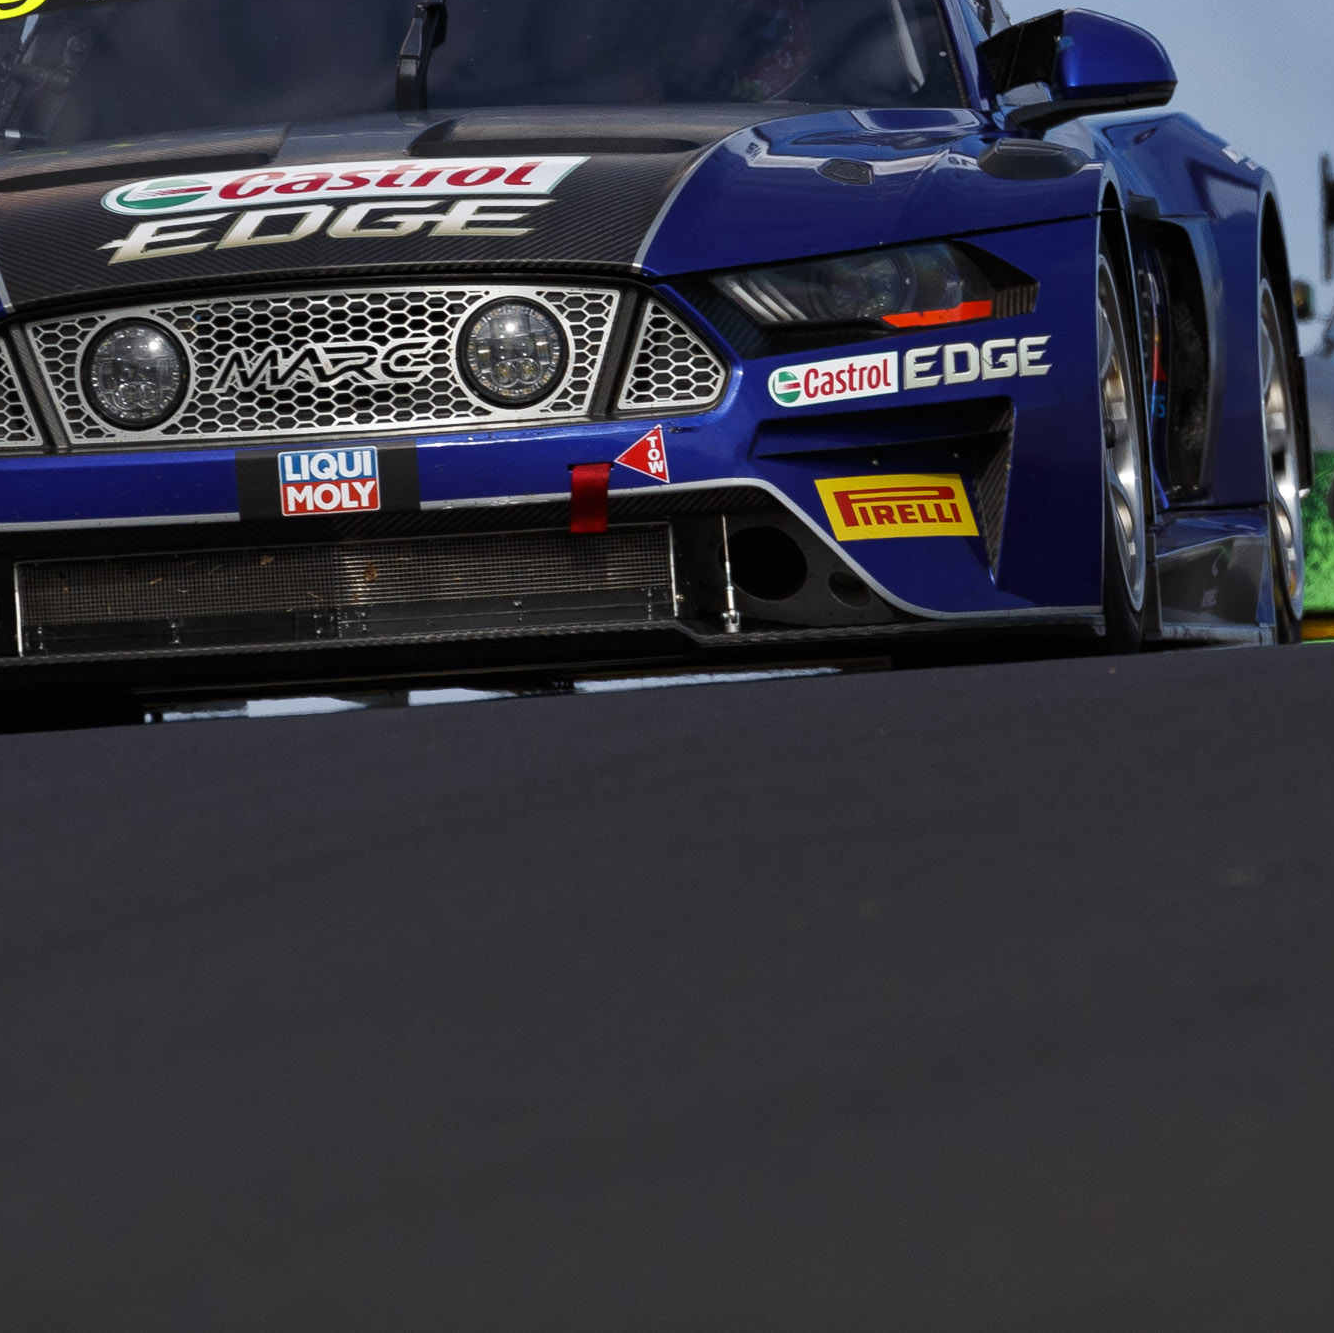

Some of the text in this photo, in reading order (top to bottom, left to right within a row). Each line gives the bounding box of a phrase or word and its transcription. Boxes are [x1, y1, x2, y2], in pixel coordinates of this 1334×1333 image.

[218, 161, 534, 201] Castrol
[96, 198, 558, 266] EDGE
[211, 337, 439, 393] MARC
[803, 335, 1053, 399] Castrol EDGE
[284, 450, 373, 481] LIQUI
[646, 435, 664, 474] TOW
[286, 480, 376, 512] MOLY
[832, 486, 963, 528] PIRELLI
